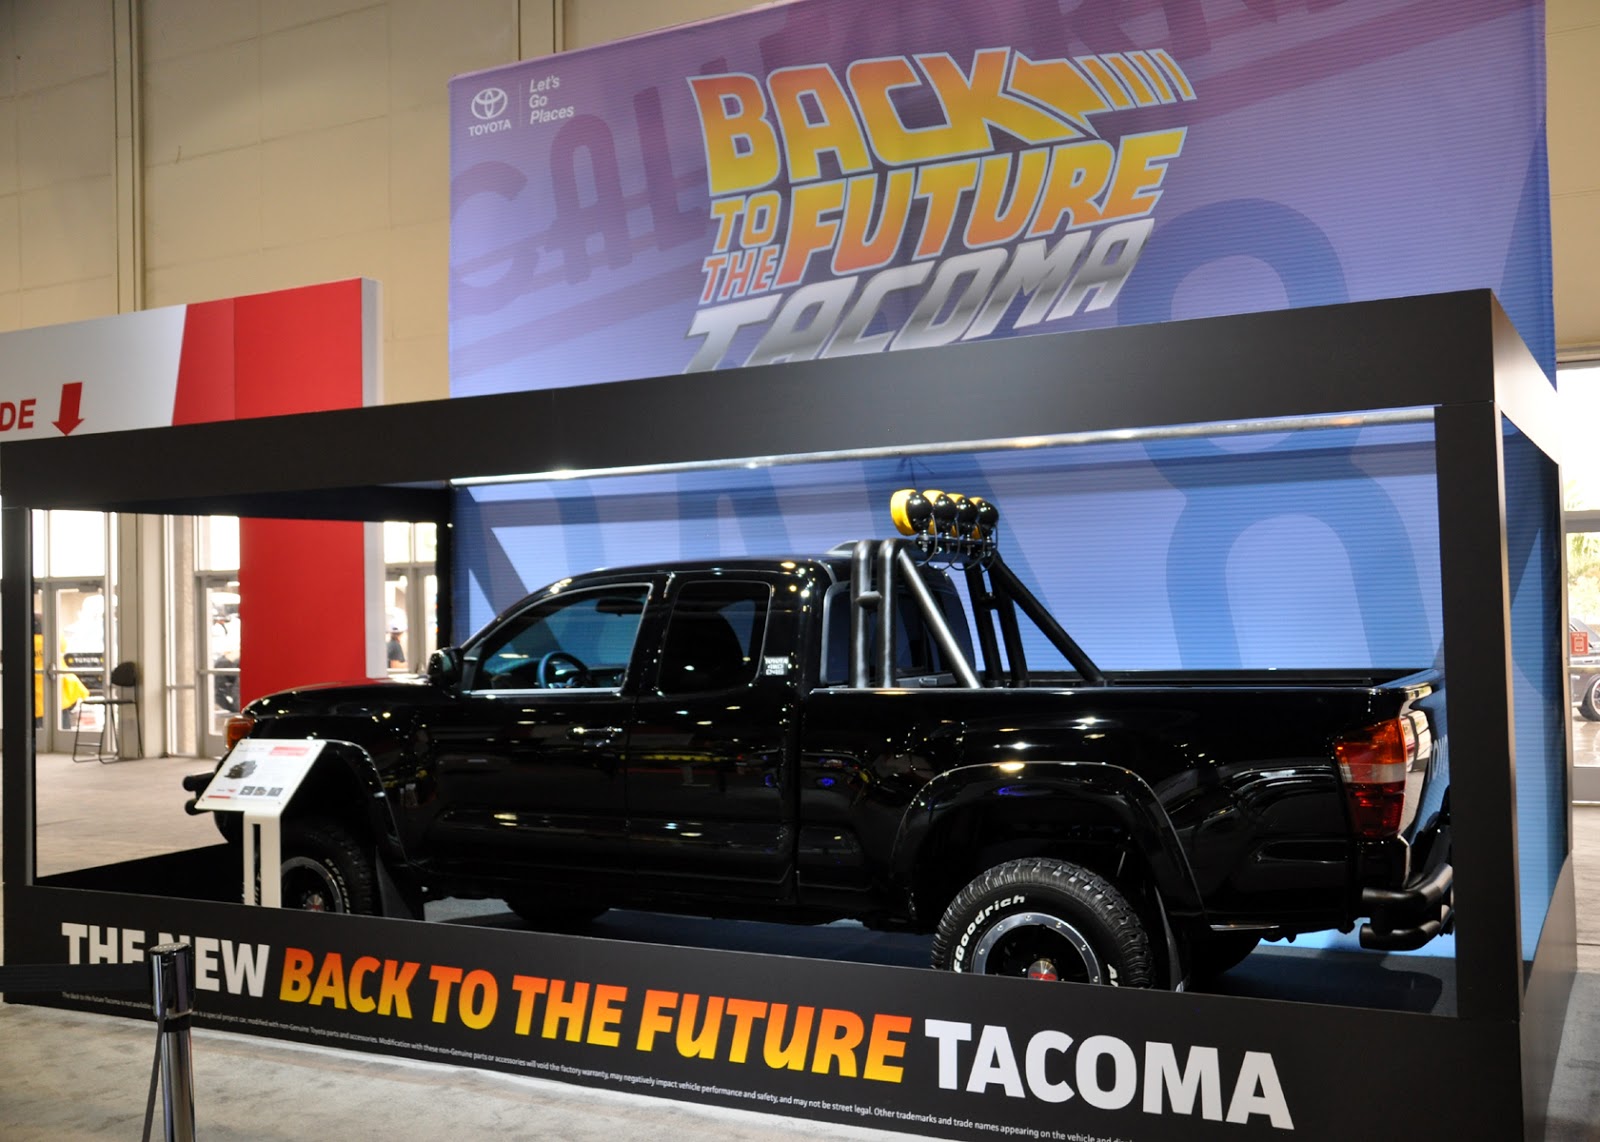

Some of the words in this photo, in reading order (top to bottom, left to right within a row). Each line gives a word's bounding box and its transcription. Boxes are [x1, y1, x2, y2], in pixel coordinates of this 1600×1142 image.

[529, 75, 560, 93] Let's
[529, 94, 548, 108] Go
[468, 119, 511, 136] TOYOTA
[529, 106, 575, 125] Places
[686, 47, 1086, 196] BACK
[710, 191, 781, 251] TO
[776, 127, 1187, 286] FUTURE
[683, 218, 1155, 374] TACOMA
[700, 244, 777, 304] THE
[0, 398, 37, 432] DE
[158, 932, 270, 998] EW
[279, 947, 421, 1019] BACK
[429, 965, 499, 1030] TO
[512, 975, 628, 1048] THE
[636, 989, 912, 1083] FUTURE
[925, 1018, 1295, 1130] TACOMA
[310, 1026, 326, 1036] Toyota
[379, 1037, 411, 1049] Modification
[411, 1042, 423, 1051] with
[423, 1044, 438, 1053] these
[439, 1047, 472, 1059] non-Genuine
[473, 1051, 488, 1060] parts
[495, 1055, 526, 1067] accessories
[526, 1059, 536, 1068] will
[537, 1062, 549, 1070] void
[549, 1063, 560, 1072] the
[560, 1064, 581, 1076] factory
[582, 1069, 609, 1080] warranty,
[610, 1073, 622, 1082] may
[623, 1074, 655, 1087] negatively
[656, 1078, 678, 1089] impact
[679, 1081, 701, 1092] vehicle
[701, 1084, 743, 1098] performance
[743, 1091, 756, 1099] and
[757, 1092, 779, 1104] safety,
[779, 1095, 792, 1104] and
[793, 1097, 807, 1108] may
[808, 1099, 821, 1108] not
[821, 1100, 831, 1110] be
[832, 1102, 853, 1113] street
[854, 1104, 873, 1116] legal.
[874, 1107, 895, 1118] Other
[896, 1110, 937, 1123] trademarks
[938, 1116, 952, 1125] and
[953, 1118, 973, 1128] trade
[974, 1122, 999, 1132] names
[1000, 1124, 1039, 1138] appearing
[1040, 1130, 1051, 1138] on
[1052, 1130, 1066, 1140] the
[1067, 1133, 1096, 1142] vehicle
